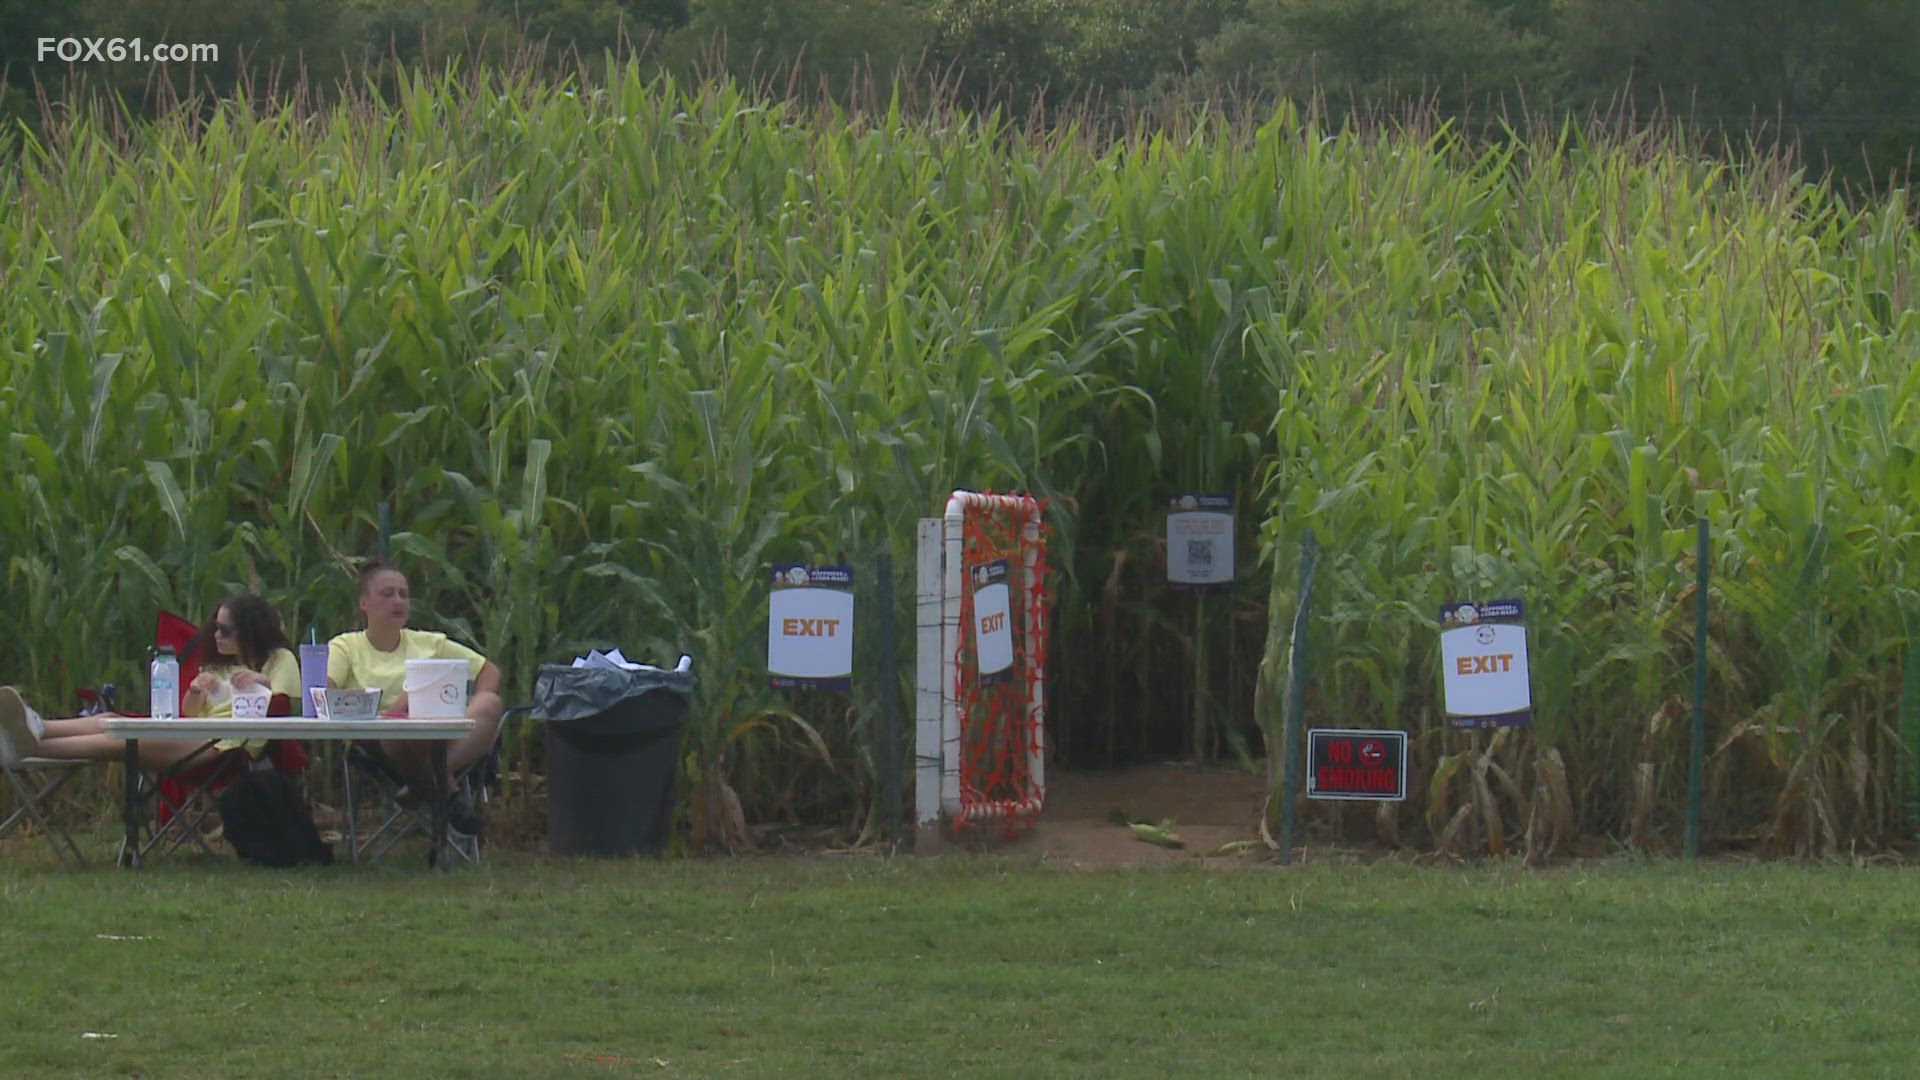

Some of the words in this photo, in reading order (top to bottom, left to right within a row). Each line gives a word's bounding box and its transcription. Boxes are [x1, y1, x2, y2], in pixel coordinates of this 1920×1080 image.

[783, 618, 839, 637] EXIT
[981, 612, 1005, 635] EXIT
[1457, 654, 1513, 675] EXIT
[1328, 740, 1352, 763] NO
[1318, 765, 1396, 792] SMOKING
